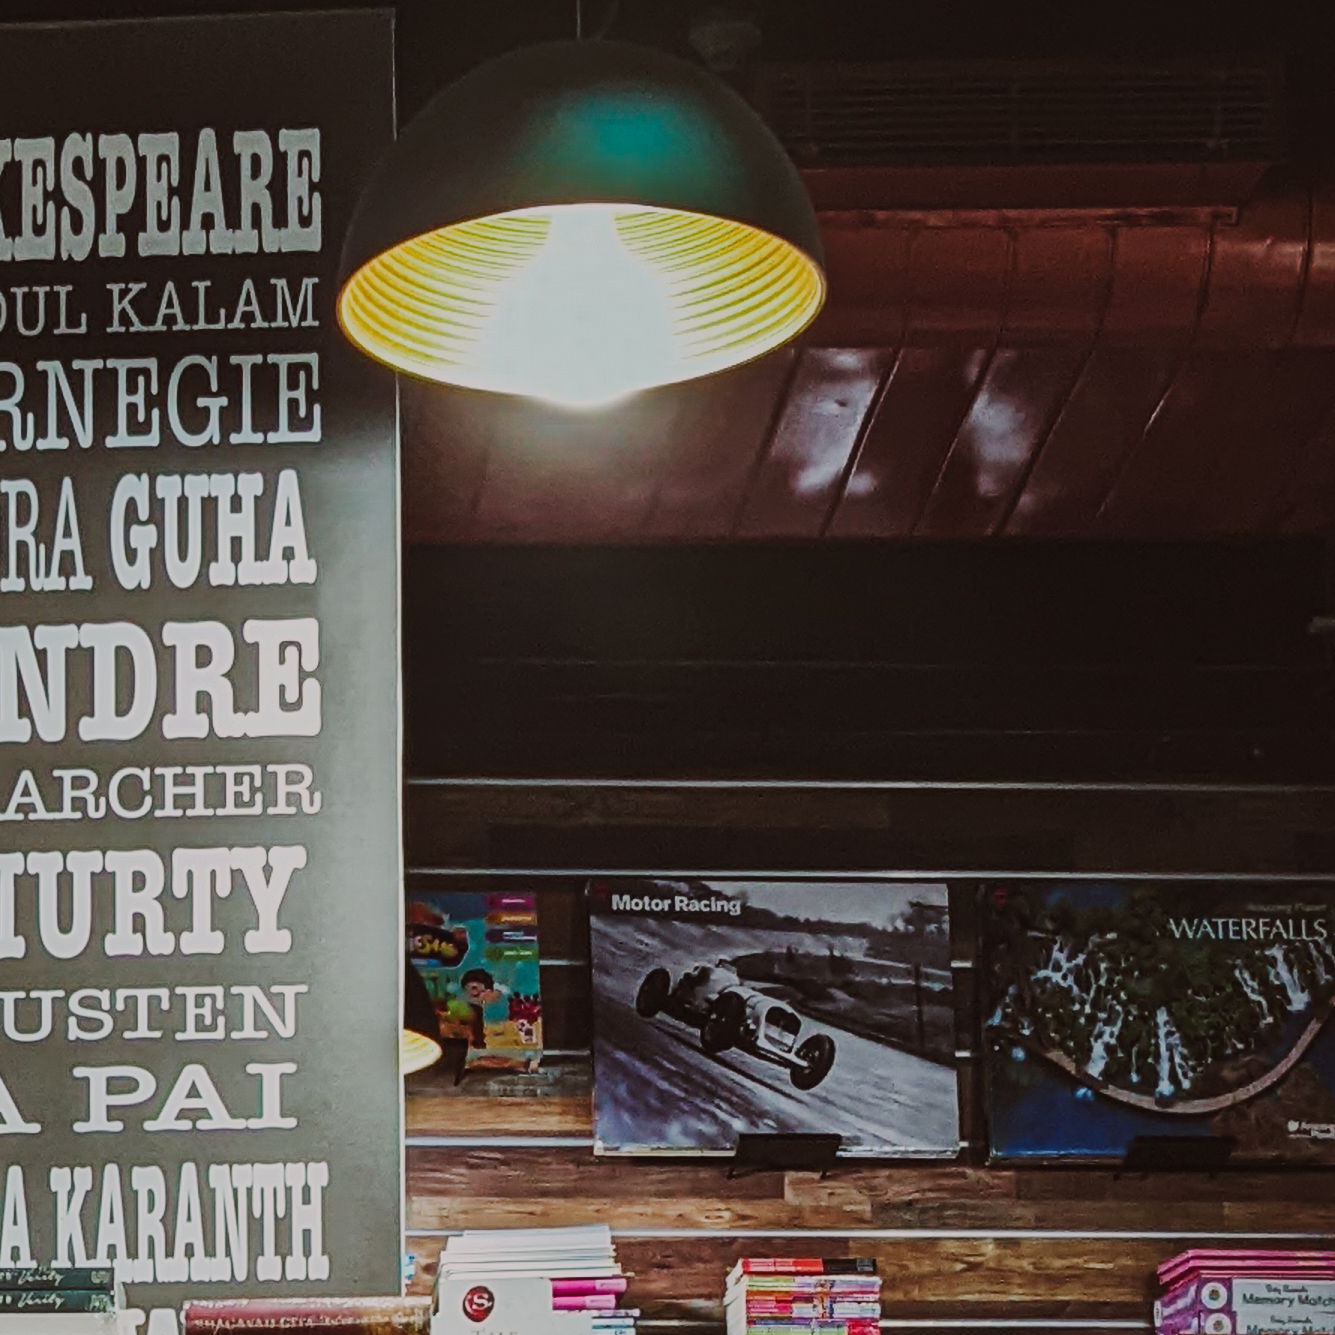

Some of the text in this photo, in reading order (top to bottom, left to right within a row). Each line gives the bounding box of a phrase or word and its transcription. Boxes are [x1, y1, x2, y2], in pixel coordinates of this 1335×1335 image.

[106, 278, 318, 333] KALAM
[110, 470, 317, 591] GUHA
[612, 894, 741, 915] Motor Racing
[1169, 918, 1327, 940] WATERFALLS
[72, 1062, 297, 1134] PAI
[52, 1162, 328, 1281] KARANTH
